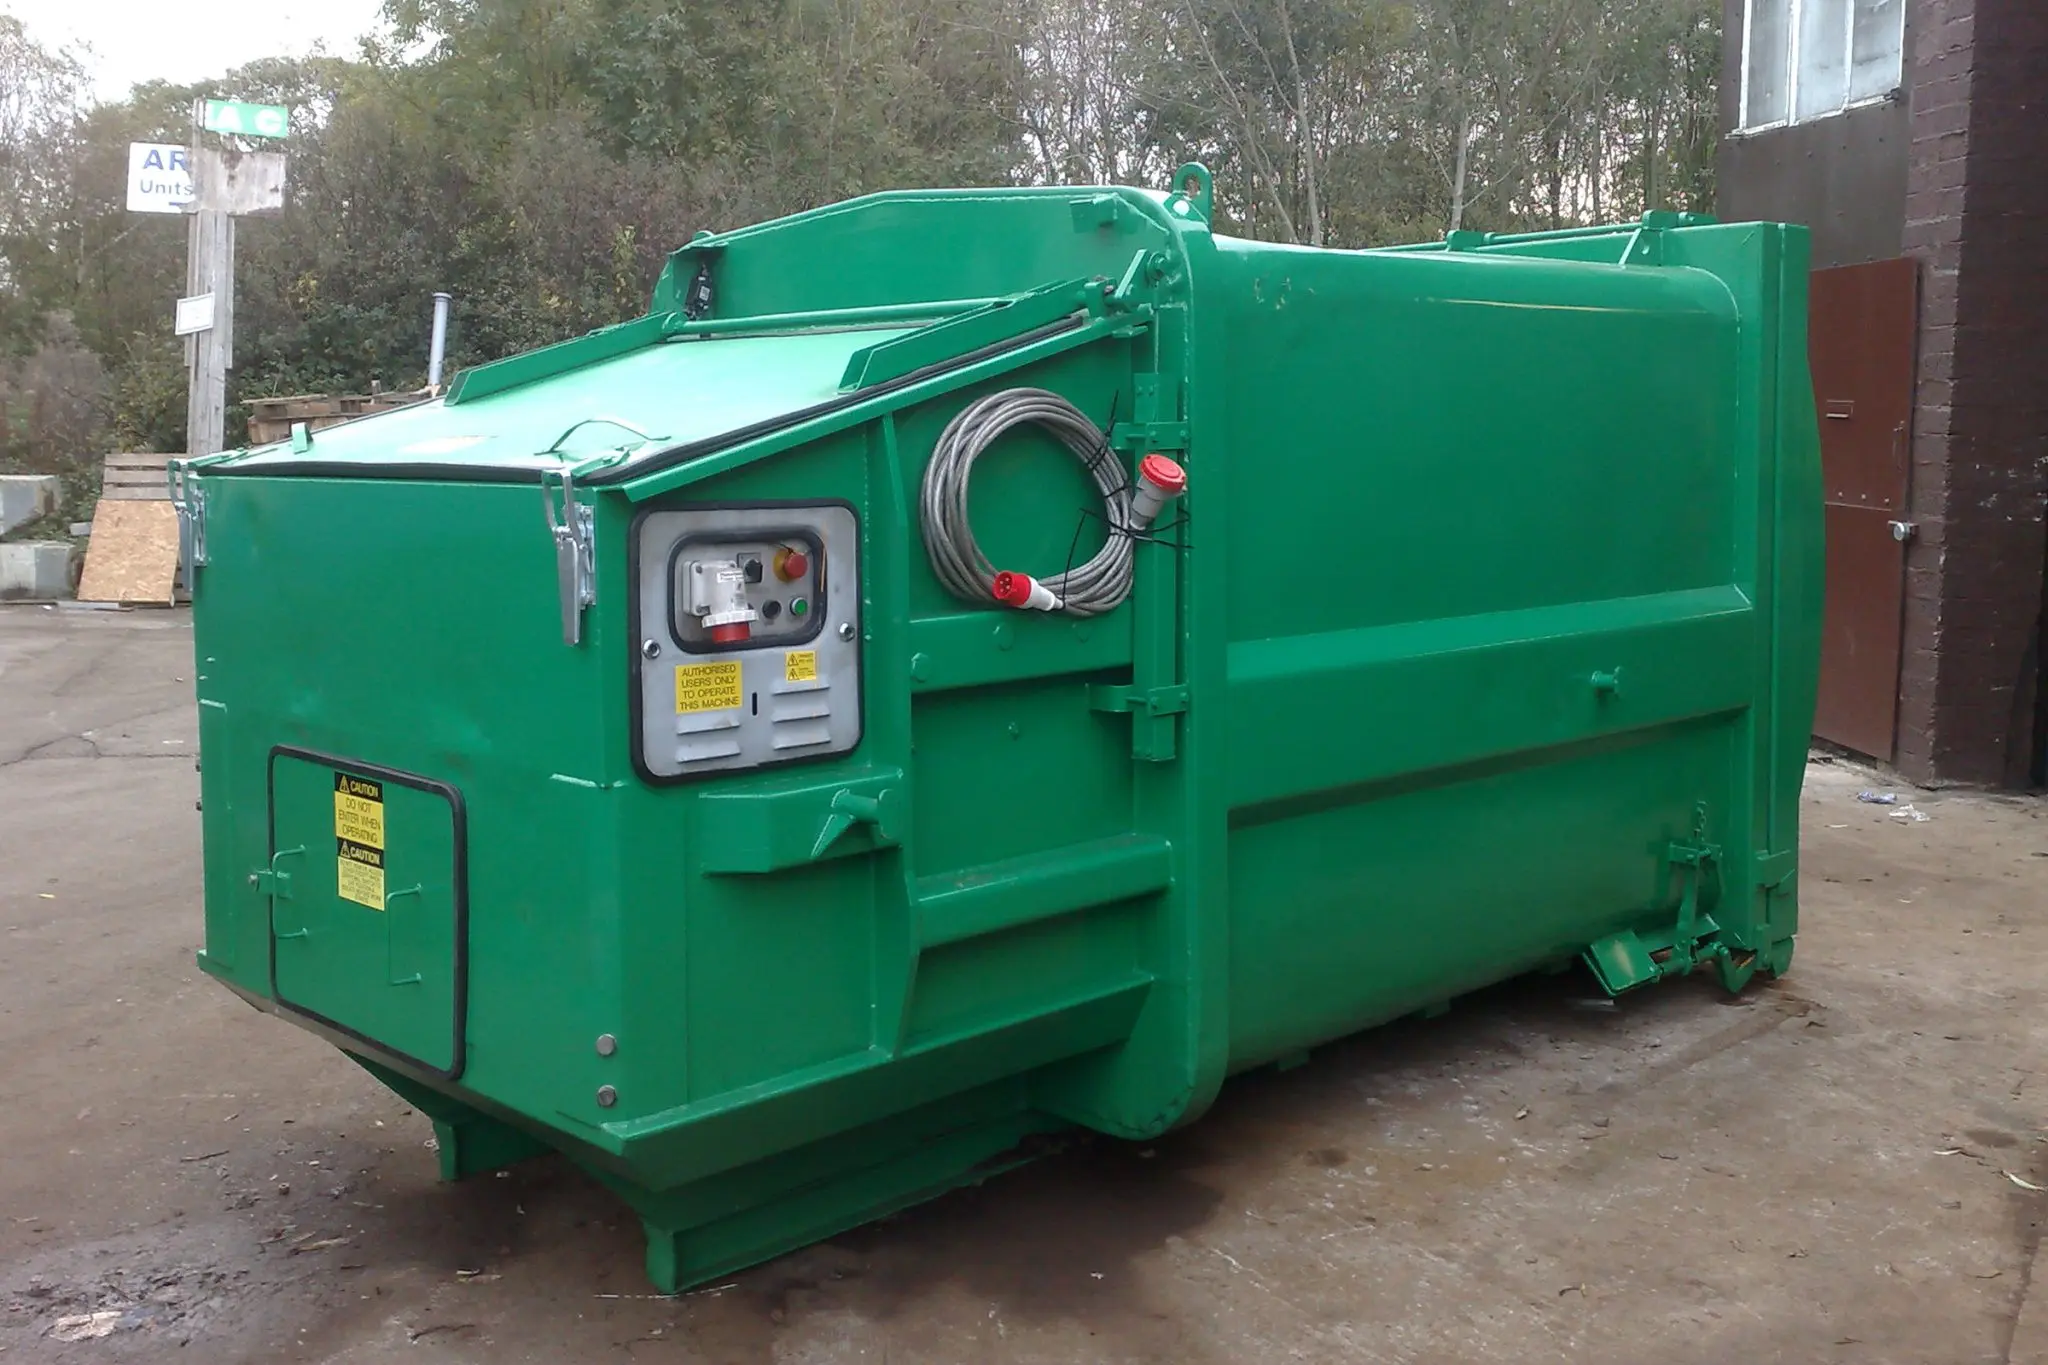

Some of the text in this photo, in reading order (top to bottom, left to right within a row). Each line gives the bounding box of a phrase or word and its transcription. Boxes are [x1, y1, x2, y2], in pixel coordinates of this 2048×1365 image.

[140, 179, 194, 196] Units
[682, 664, 736, 677] AUTHORISED
[681, 675, 736, 689] USERS ONLY
[683, 686, 736, 700] TO OPERATE
[680, 696, 739, 711] THIS MACHINE
[350, 780, 379, 798] CAUTION
[350, 846, 380, 866] CAUTION
